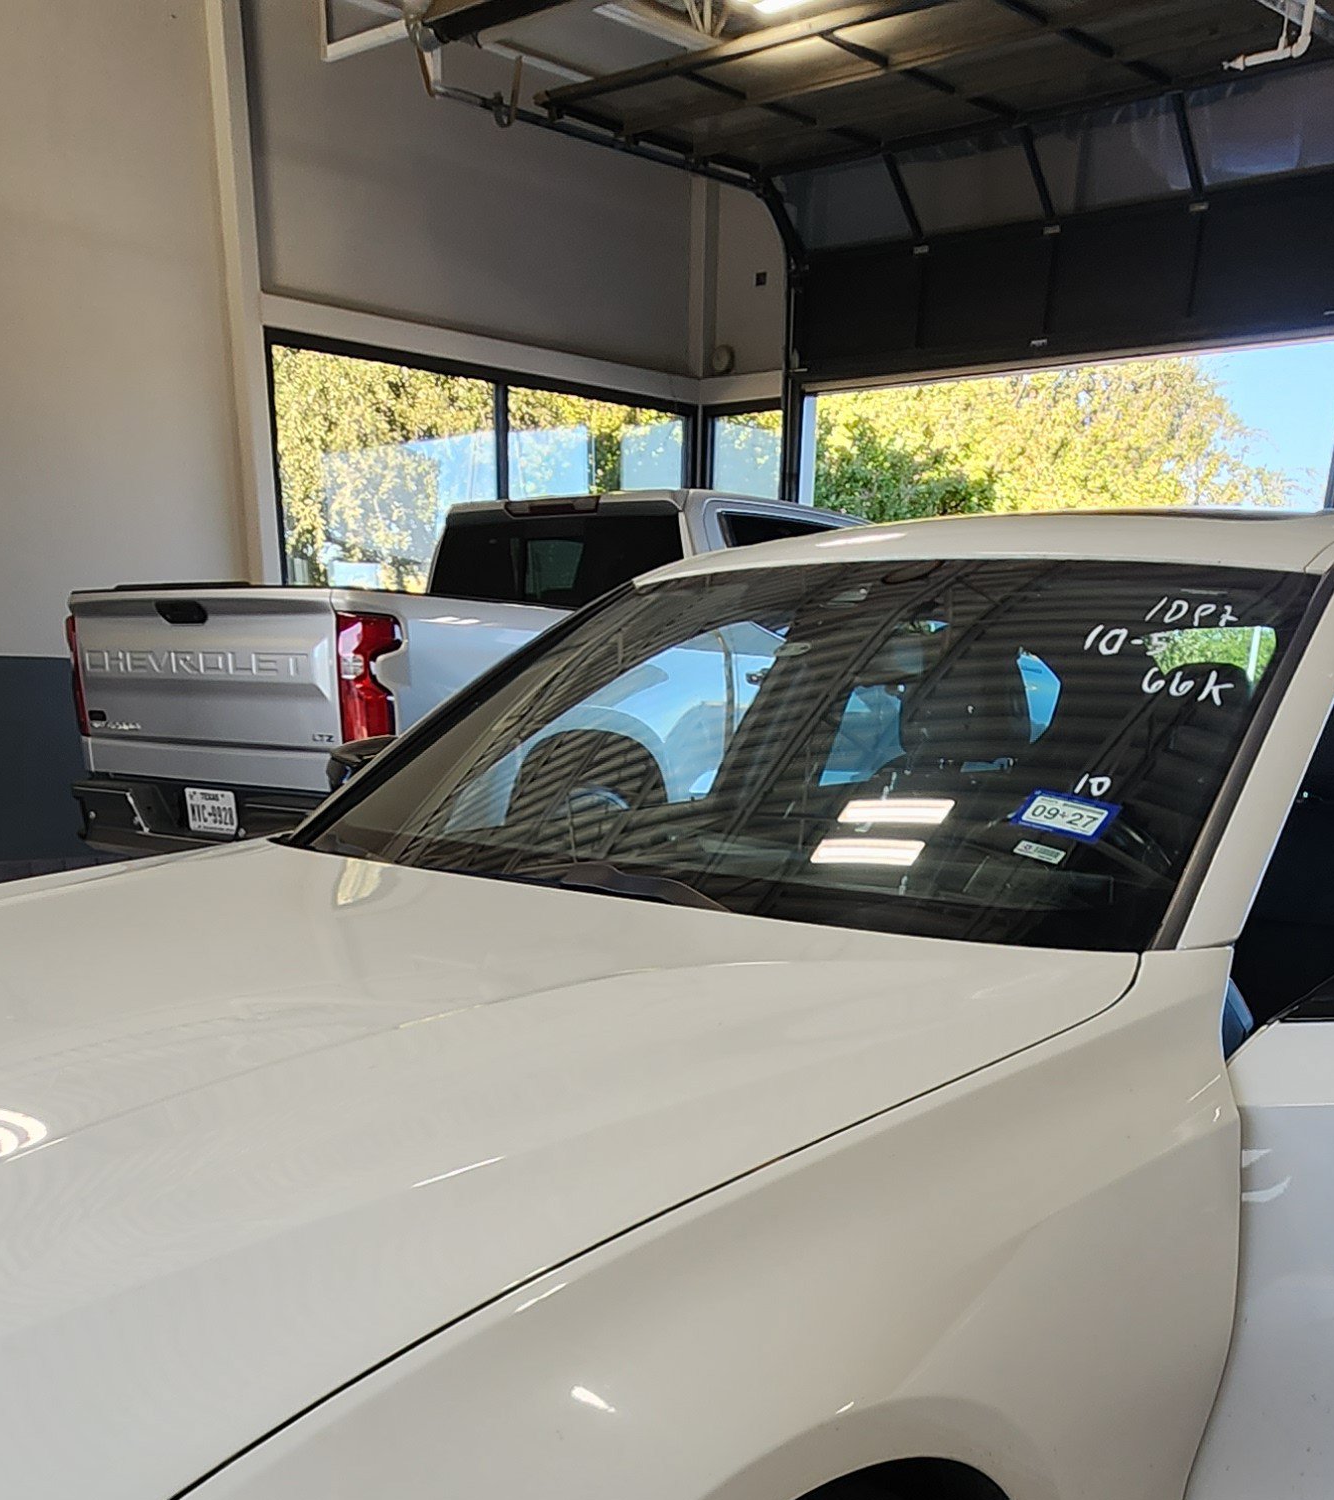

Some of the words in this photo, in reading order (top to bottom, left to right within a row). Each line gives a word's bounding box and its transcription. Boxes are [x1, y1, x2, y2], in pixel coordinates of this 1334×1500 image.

[85, 650, 309, 677] CHEVROLET
[312, 732, 335, 743] LTZ
[1073, 772, 1113, 796] 10
[1030, 803, 1061, 820] 09
[1066, 811, 1099, 829] 27
